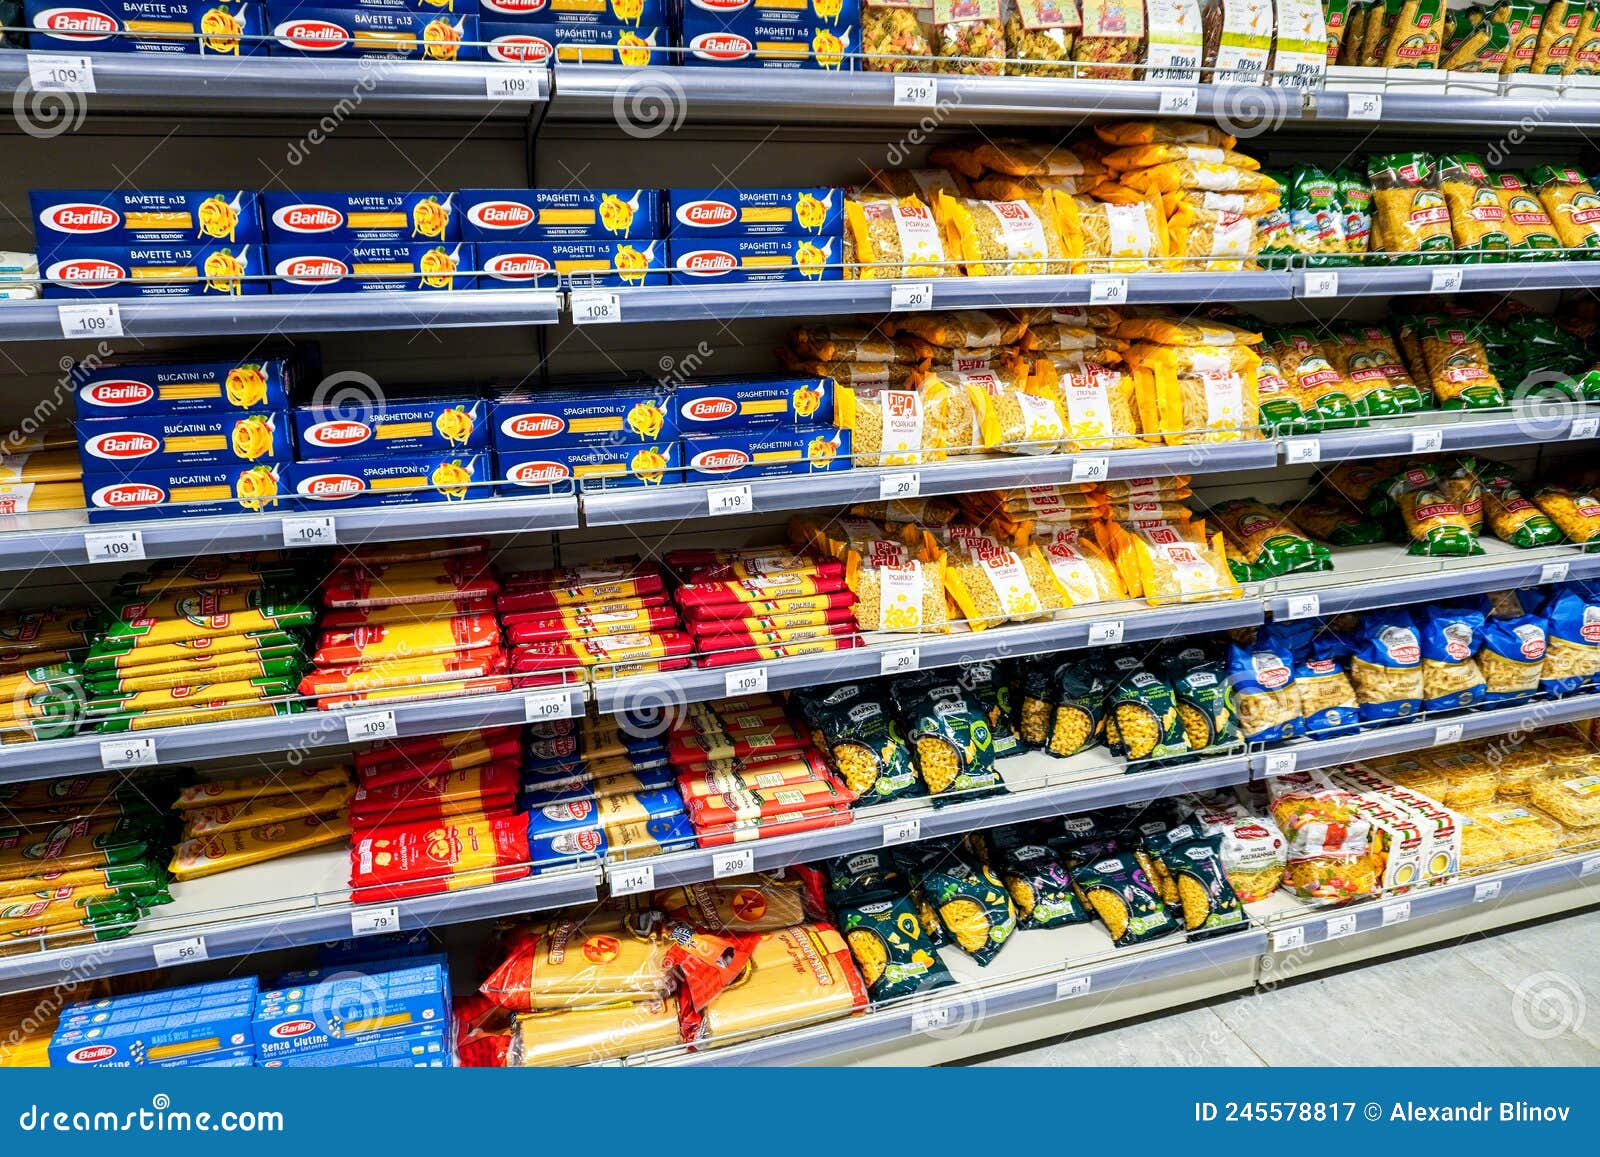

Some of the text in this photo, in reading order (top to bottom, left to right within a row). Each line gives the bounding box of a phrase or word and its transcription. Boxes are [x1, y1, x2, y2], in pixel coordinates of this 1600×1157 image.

[123, 2, 166, 13] BAVETTE
[54, 14, 112, 33] Barilla
[354, 14, 394, 24] BAVETTE
[292, 26, 343, 39] Barilla
[555, 29, 598, 38] SPAGHETTI
[754, 27, 796, 36] SPAGHETTI
[705, 39, 747, 53] Barilla
[1171, 55, 1196, 67] ПЕРЬЯ
[1237, 58, 1262, 70] ПЕРЬЯ
[1152, 69, 1163, 79] ИЗ
[1296, 63, 1320, 75] ПЕРЬЯ
[49, 69, 77, 83] 109
[501, 79, 526, 91] 109
[906, 87, 926, 98] 219
[125, 196, 166, 204] BAVETTE
[348, 197, 383, 205] BAVETTE
[536, 194, 580, 202] SPAGHETTI
[740, 193, 779, 201] SPAGHETTI
[59, 211, 112, 225] Barilla
[289, 211, 335, 225] Barilla
[482, 208, 529, 221] Barilla
[691, 207, 732, 220] Barilla
[353, 248, 390, 256] BAVETTE
[552, 246, 595, 254] SPAGHETTI
[739, 242, 779, 250] SPAGHETTI
[131, 250, 171, 259] BAVETTE
[293, 263, 341, 276] Barilla
[500, 260, 545, 272] Barilla
[690, 257, 732, 270] Barilla
[66, 266, 119, 280] Barilla
[1107, 286, 1119, 297] 20
[909, 294, 922, 304] 20
[587, 305, 609, 317] 108
[79, 316, 106, 330] 109
[158, 372, 200, 382] BUCATINI
[98, 385, 147, 400] Barilla
[737, 389, 778, 399] SPAGHETTINI
[563, 405, 614, 415] SPAGHETTONI
[694, 401, 733, 414] Barilla
[369, 412, 422, 422] SPAGHETTONI
[164, 424, 206, 433] BUCATINI
[515, 419, 559, 433] Barilla
[320, 426, 366, 441] Barilla
[103, 436, 152, 451] Barilla
[748, 441, 792, 451] SPAGHETTINI
[567, 453, 618, 463] SPAGHETTONI
[705, 452, 745, 466] Barilla
[363, 465, 417, 476] SPAGHETTONI
[521, 466, 564, 481] Barilla
[1088, 466, 1100, 477] 20
[169, 475, 212, 485] BUCATINI
[314, 479, 358, 494] Barilla
[898, 482, 910, 493] 20
[110, 489, 158, 503] Barilla
[721, 495, 742, 508] 119
[298, 527, 323, 540] 104
[103, 542, 130, 555] 109
[1105, 629, 1116, 639] 19
[898, 656, 909, 667] 20
[738, 677, 758, 689] 109
[539, 704, 560, 716] 109
[851, 703, 880, 717] МАРКЕТ
[363, 721, 386, 734] 109
[125, 748, 142, 760] 91
[900, 828, 911, 839] 61
[725, 860, 743, 871] 209
[850, 856, 877, 869] МАРКЕТ
[624, 876, 643, 888] 114
[373, 917, 388, 928] 79
[179, 946, 196, 958] 56
[280, 1022, 312, 1034] Barilla
[261, 1040, 292, 1053] Senza
[294, 1034, 329, 1047] Glutine
[78, 1047, 113, 1060] Barilla
